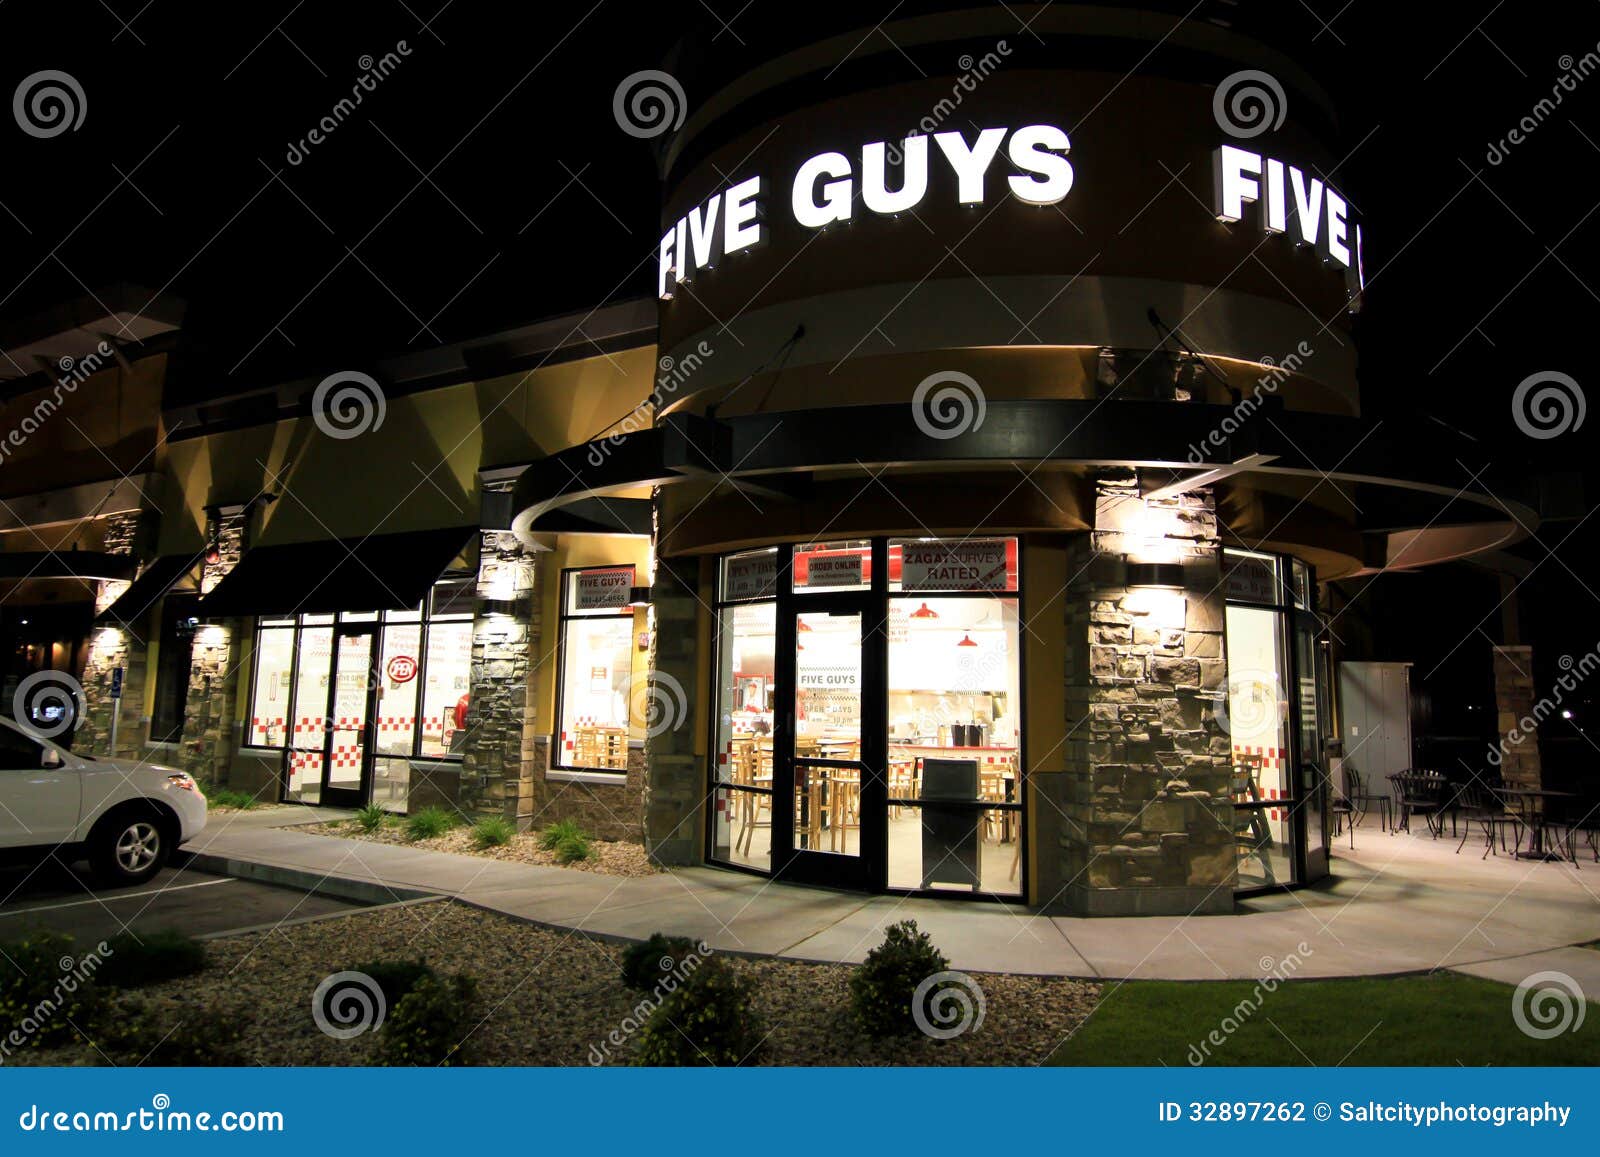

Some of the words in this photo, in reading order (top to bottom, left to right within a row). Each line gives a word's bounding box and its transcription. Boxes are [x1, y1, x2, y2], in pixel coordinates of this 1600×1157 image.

[658, 175, 761, 299] FIVE
[792, 125, 1073, 229] GUYS
[1214, 144, 1350, 268] FIVE
[809, 562, 833, 572] ORDER
[834, 560, 861, 570] ONLINE
[927, 567, 980, 580] RATED
[580, 579, 599, 588] FIVE
[601, 577, 626, 587] GUYS
[801, 675, 823, 684] FIVE
[826, 675, 856, 685] GUYS
